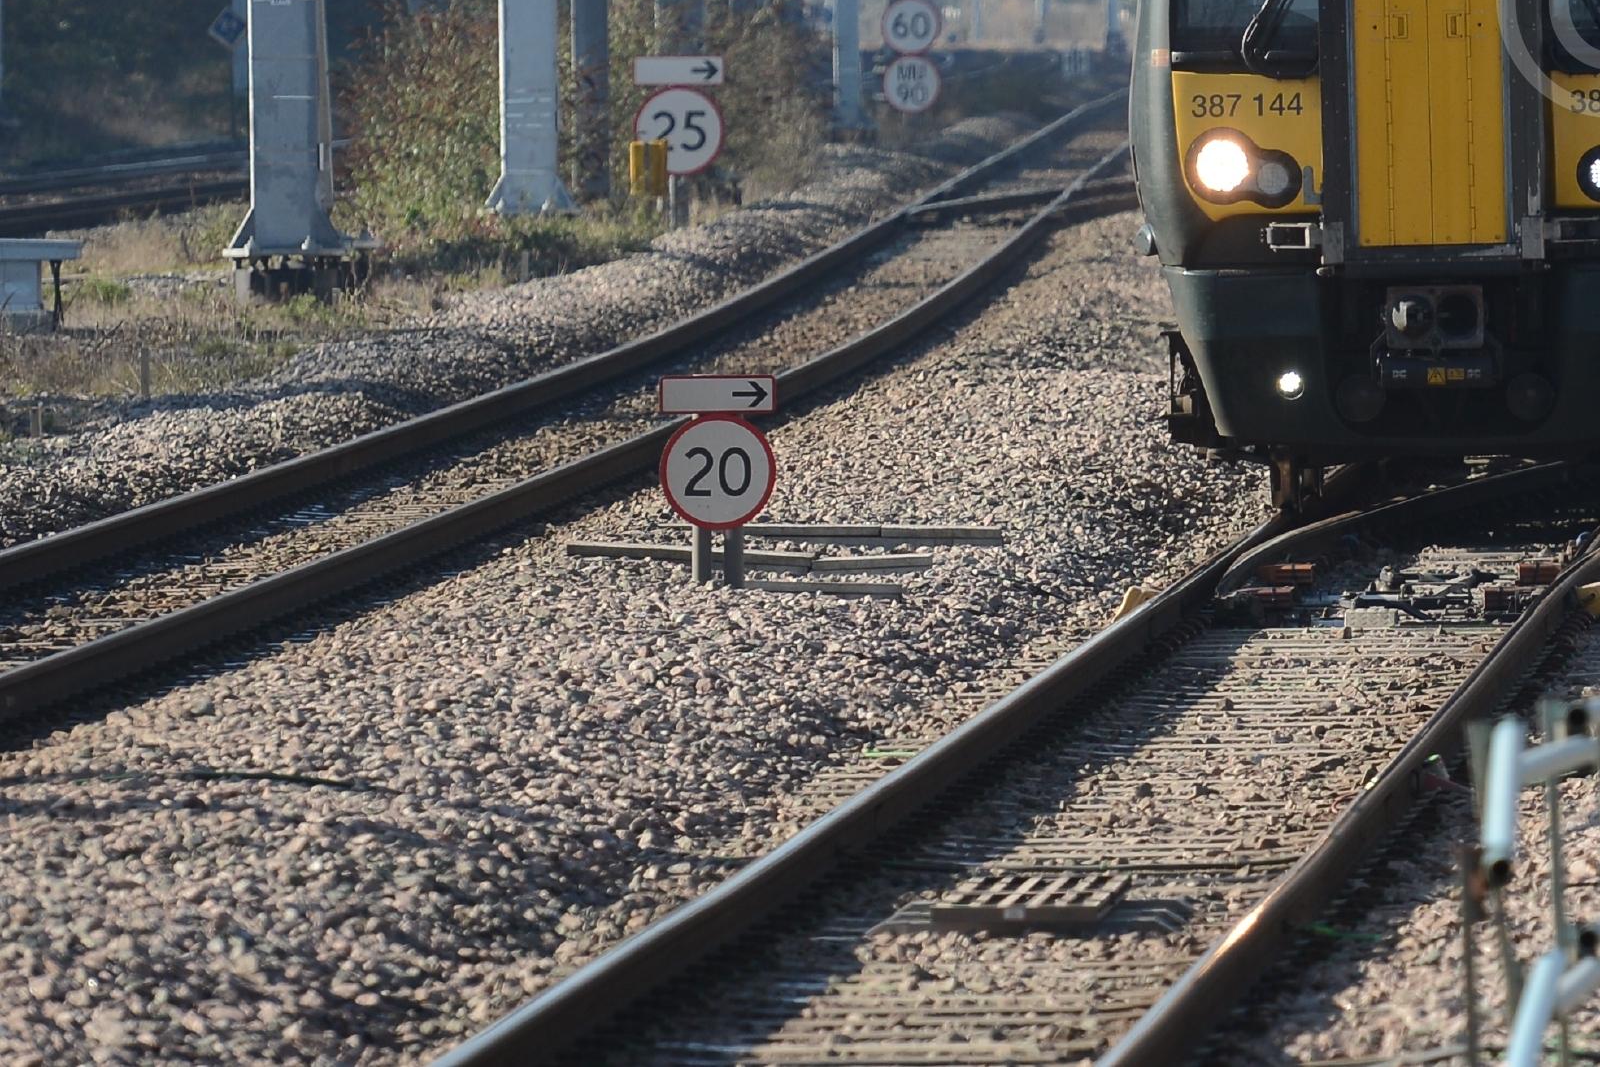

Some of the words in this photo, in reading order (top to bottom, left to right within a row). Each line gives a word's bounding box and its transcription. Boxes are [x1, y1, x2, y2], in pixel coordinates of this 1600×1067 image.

[891, 13, 931, 39] 60
[1191, 94, 1243, 118] 387
[1252, 92, 1304, 117] 144
[652, 109, 707, 152] 25
[683, 446, 753, 497] 20
